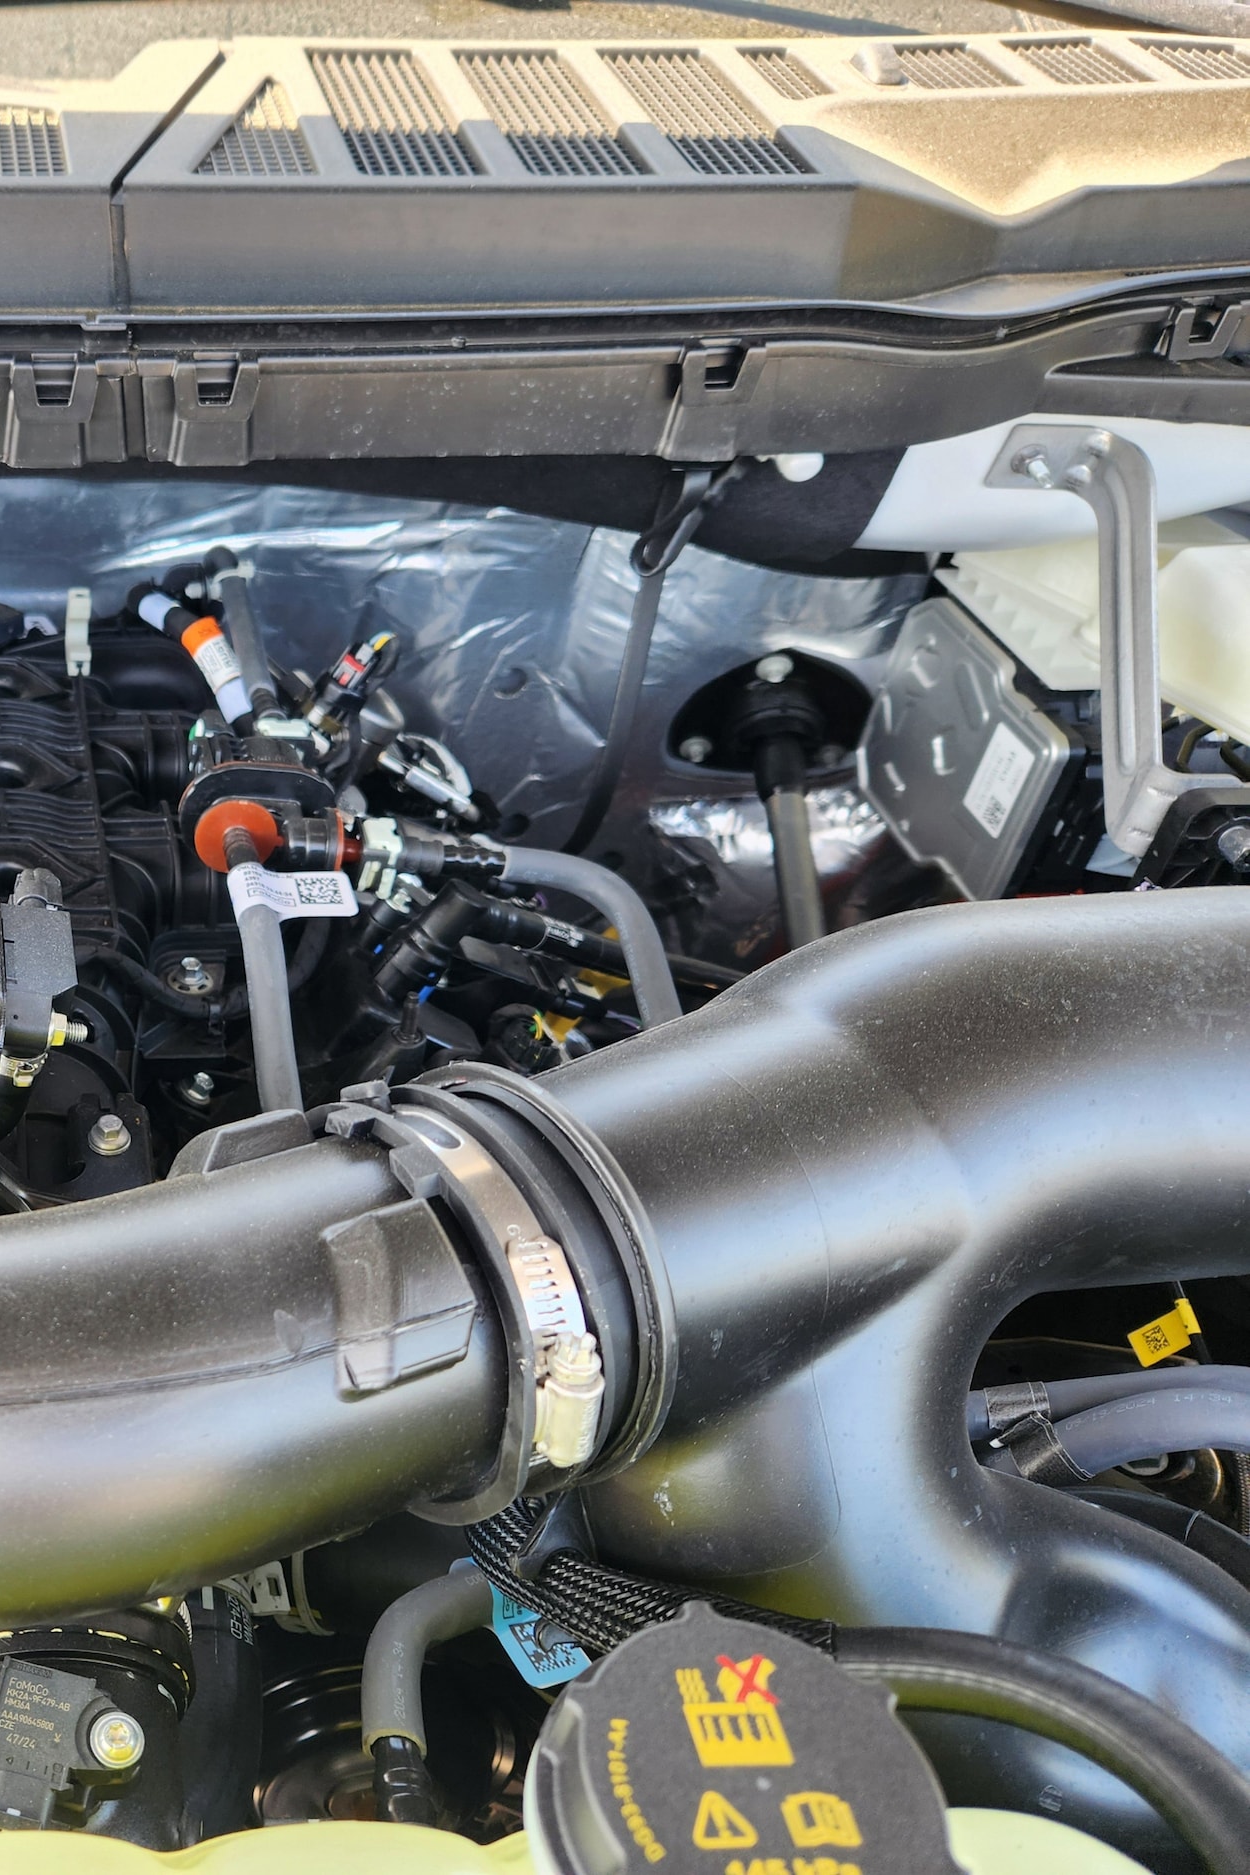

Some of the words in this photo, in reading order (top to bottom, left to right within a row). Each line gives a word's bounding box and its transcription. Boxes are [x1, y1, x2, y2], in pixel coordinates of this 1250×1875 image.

[8, 1677, 49, 1697] FoMoCo
[6, 1687, 71, 1712] KK2A-9F479-AB
[6, 1732, 37, 1749] 47/24
